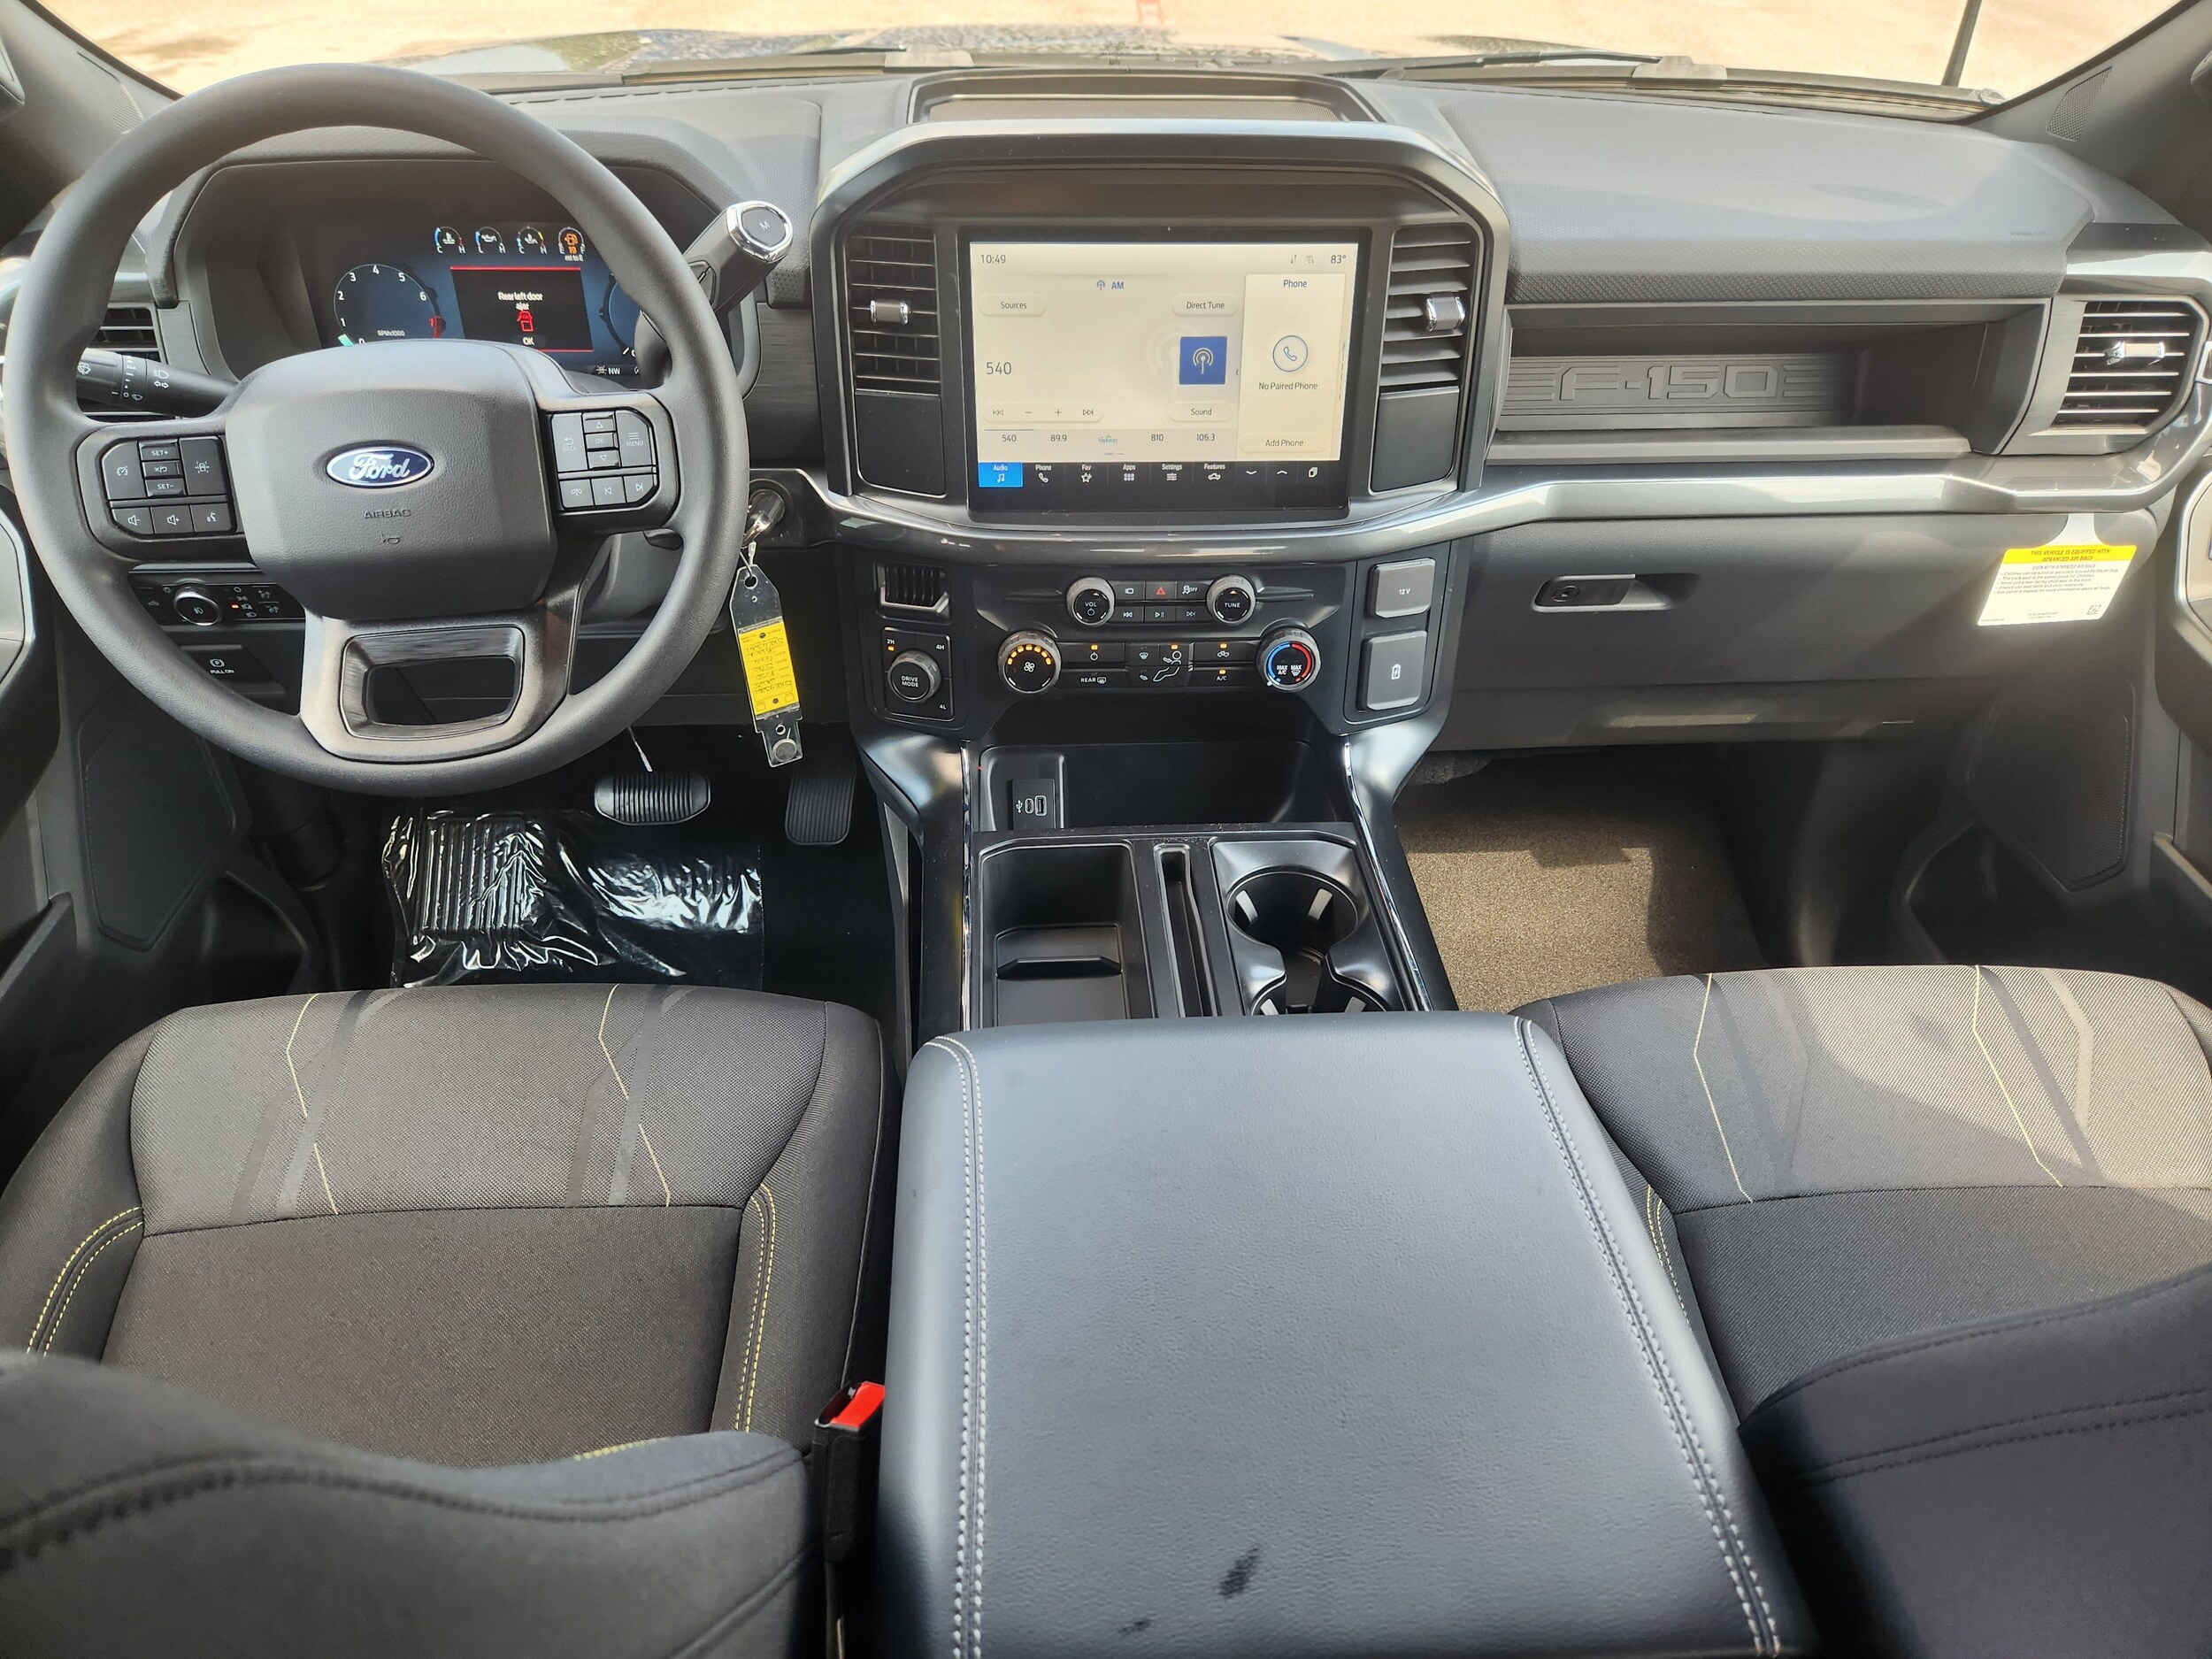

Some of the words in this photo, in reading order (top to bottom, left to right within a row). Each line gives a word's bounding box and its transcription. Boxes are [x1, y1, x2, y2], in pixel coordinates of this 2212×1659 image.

[760, 221, 770, 230] M
[981, 254, 1006, 264] 10:49
[1330, 255, 1346, 264] 83°
[373, 265, 380, 275] 4
[349, 272, 356, 282] 3
[398, 272, 406, 282] 5
[1283, 279, 1307, 288] Phone
[338, 291, 345, 300] 2
[419, 291, 427, 301] 6
[498, 292, 513, 301] Rear
[513, 292, 527, 300] left
[527, 292, 543, 301] door
[516, 302, 530, 311] ajar
[1186, 301, 1206, 310] Direct
[1208, 301, 1224, 310] Tune
[341, 317, 346, 327] 1
[523, 337, 535, 345] OK
[986, 362, 1012, 375] 540
[1270, 382, 1293, 390] Paired
[1559, 364, 1778, 401] F-150
[349, 453, 410, 480] Ford
[364, 509, 411, 519] AIRBAG
